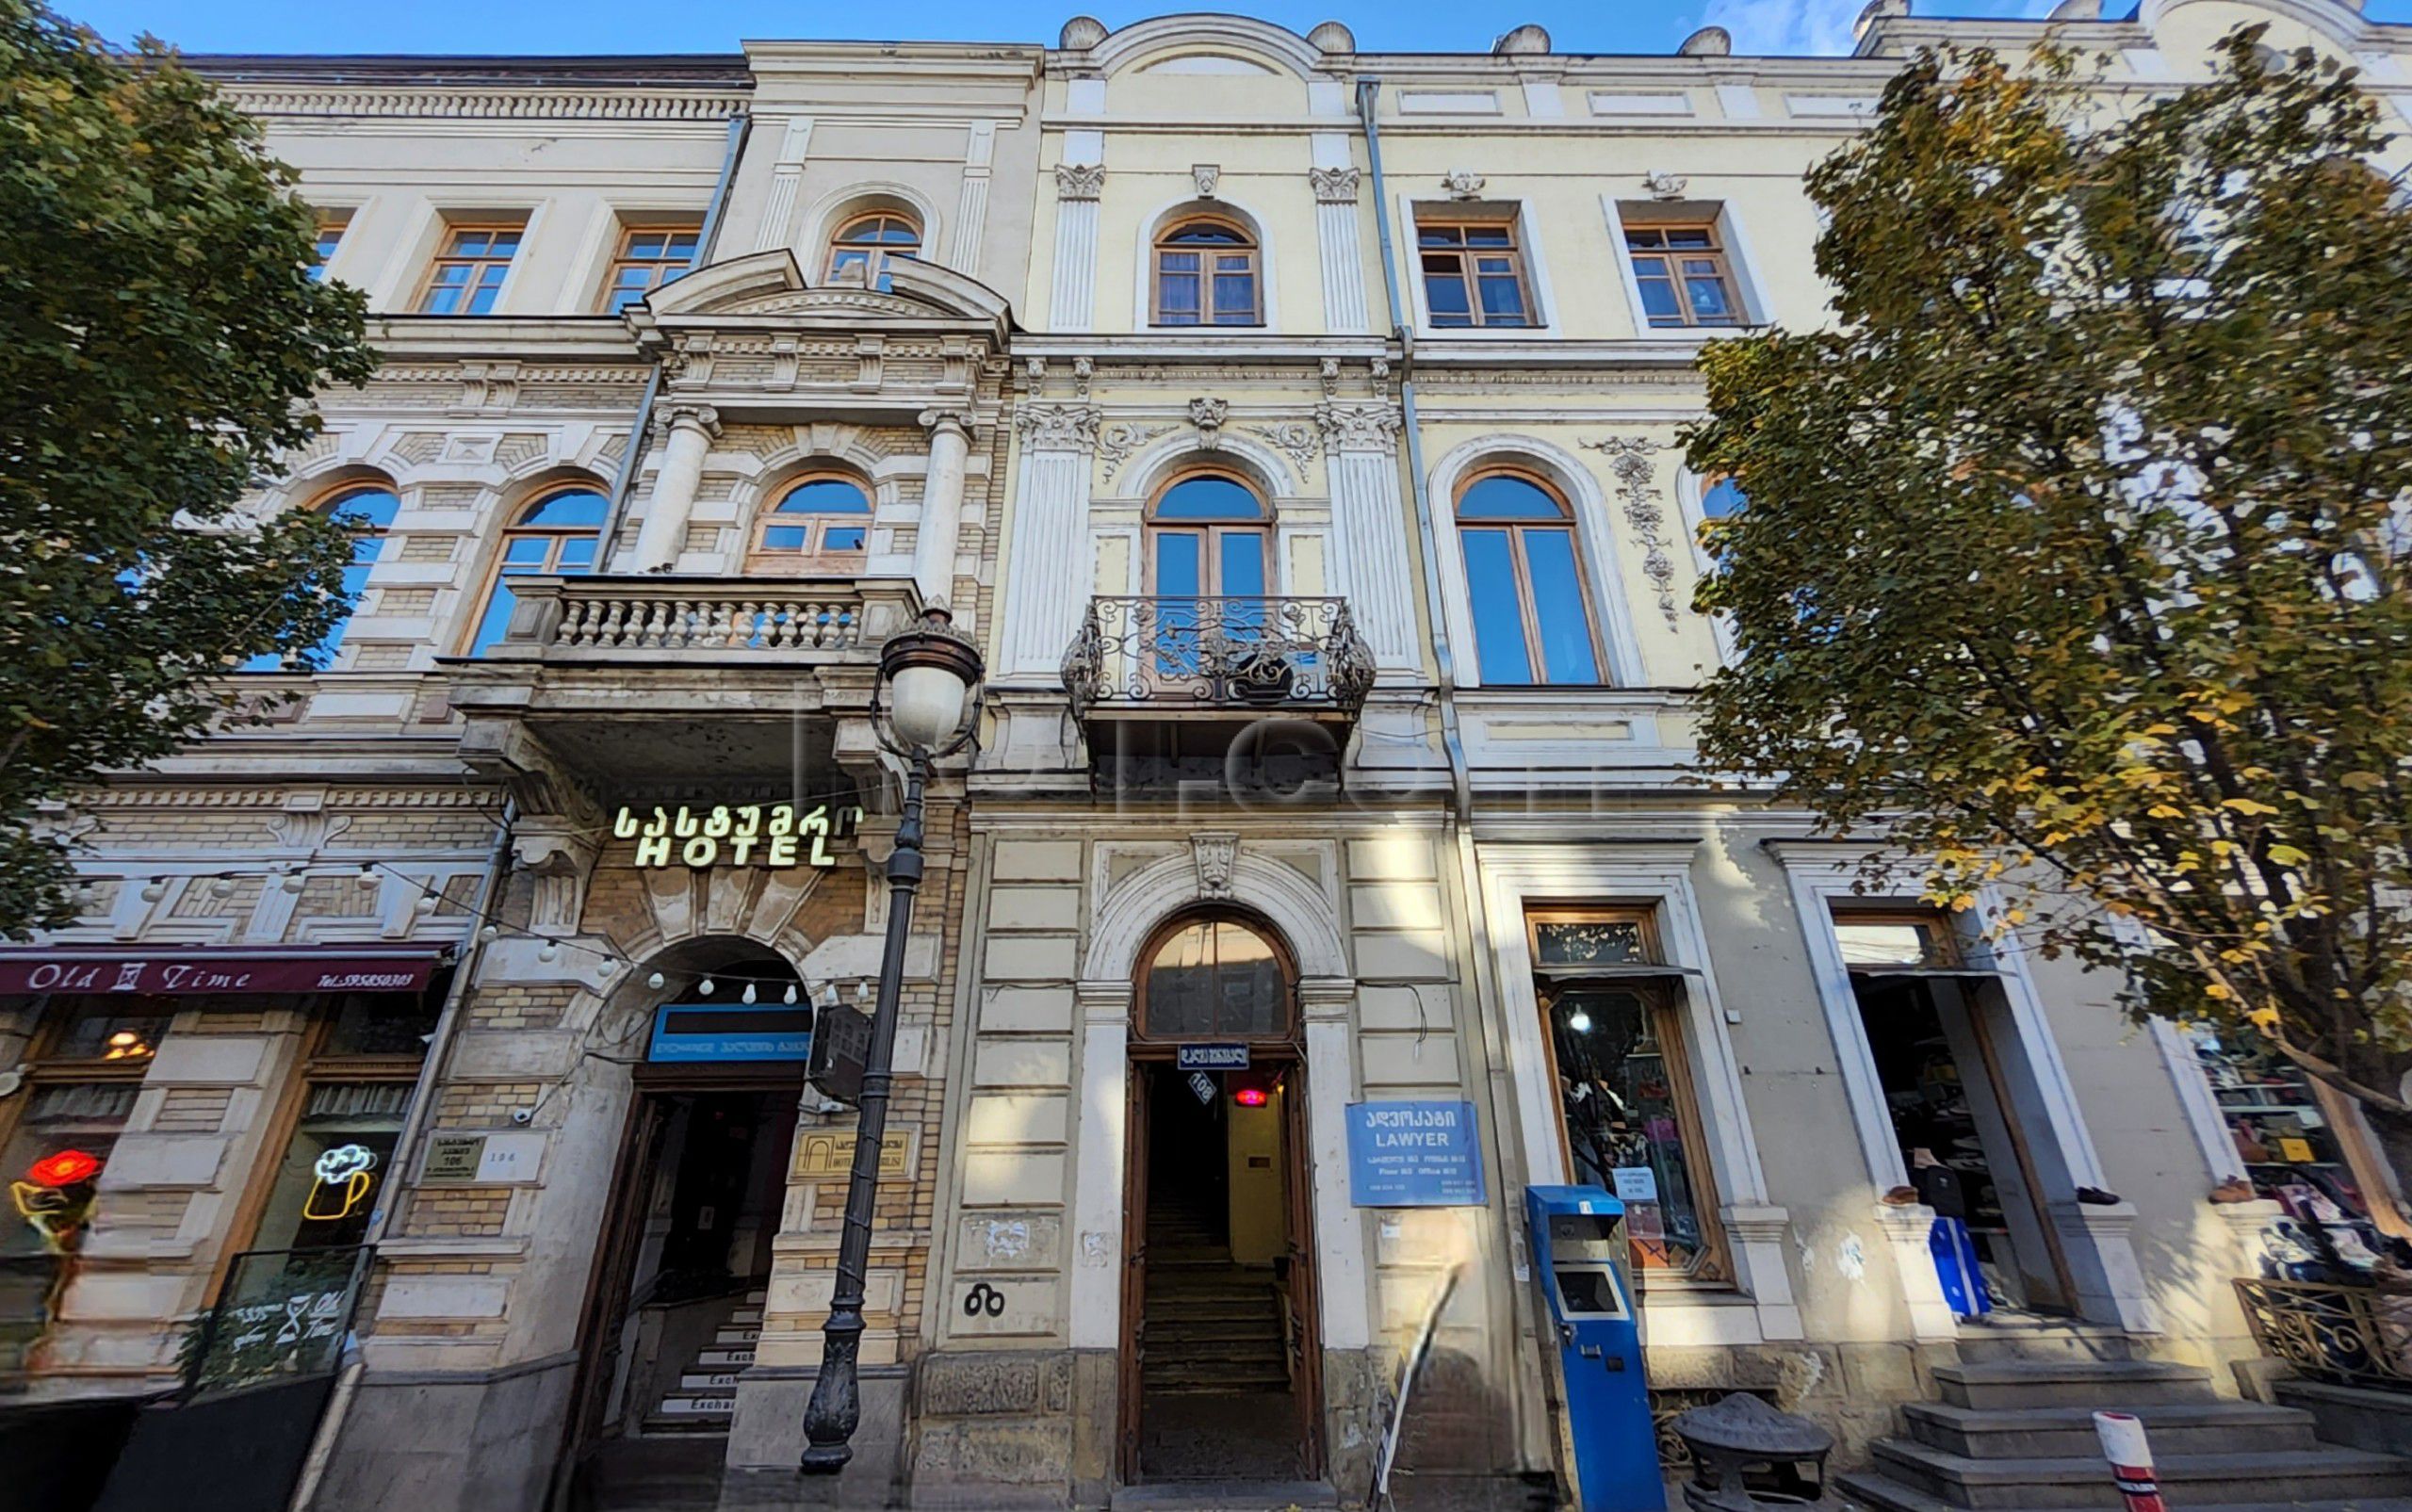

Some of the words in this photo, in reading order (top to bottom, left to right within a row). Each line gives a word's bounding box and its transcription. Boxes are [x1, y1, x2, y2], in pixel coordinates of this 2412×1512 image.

[613, 805, 864, 838] სასტუმრო
[634, 836, 835, 867] HOTEL
[27, 964, 101, 989] Old
[162, 965, 252, 989] Time
[1366, 1111, 1456, 1128] ადვოკატი
[1376, 1132, 1450, 1147] LAWYER
